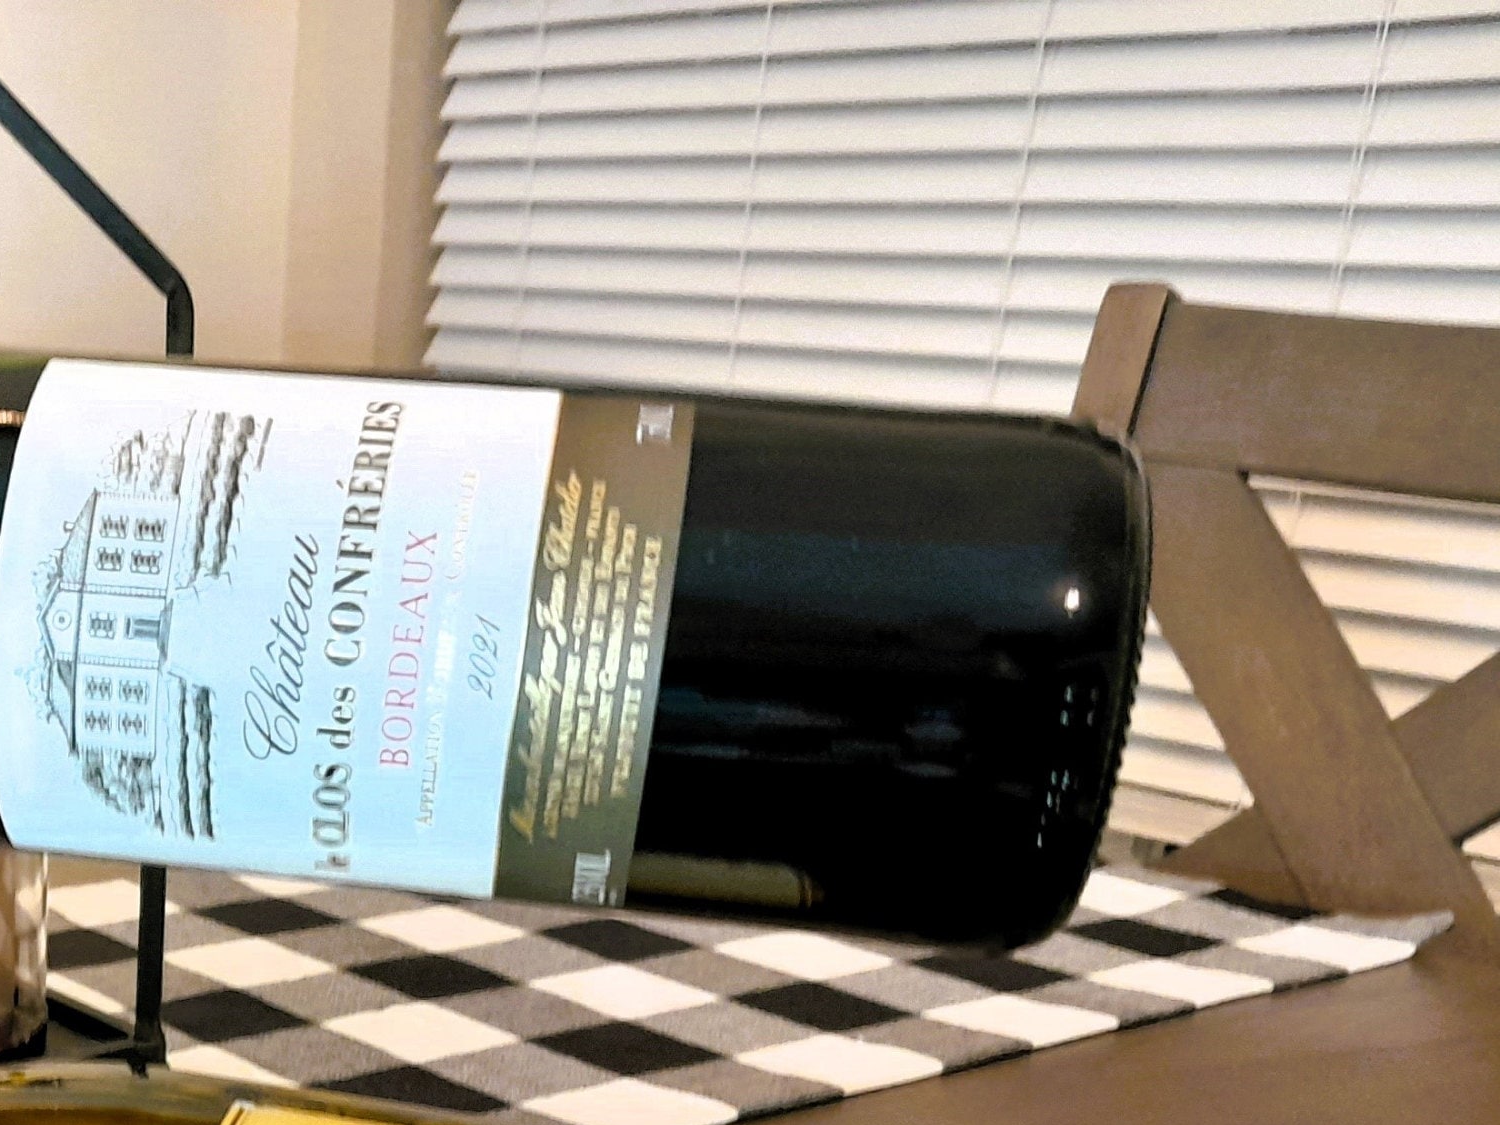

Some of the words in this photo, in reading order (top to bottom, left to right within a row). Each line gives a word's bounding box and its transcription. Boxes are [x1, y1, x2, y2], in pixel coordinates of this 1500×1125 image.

[324, 401, 405, 667] CONFRÉRIES
[243, 533, 320, 760] Château
[316, 686, 357, 750] des
[380, 530, 438, 767] BORDEAUX
[467, 613, 501, 701] 2021
[312, 763, 352, 848] CLOS
